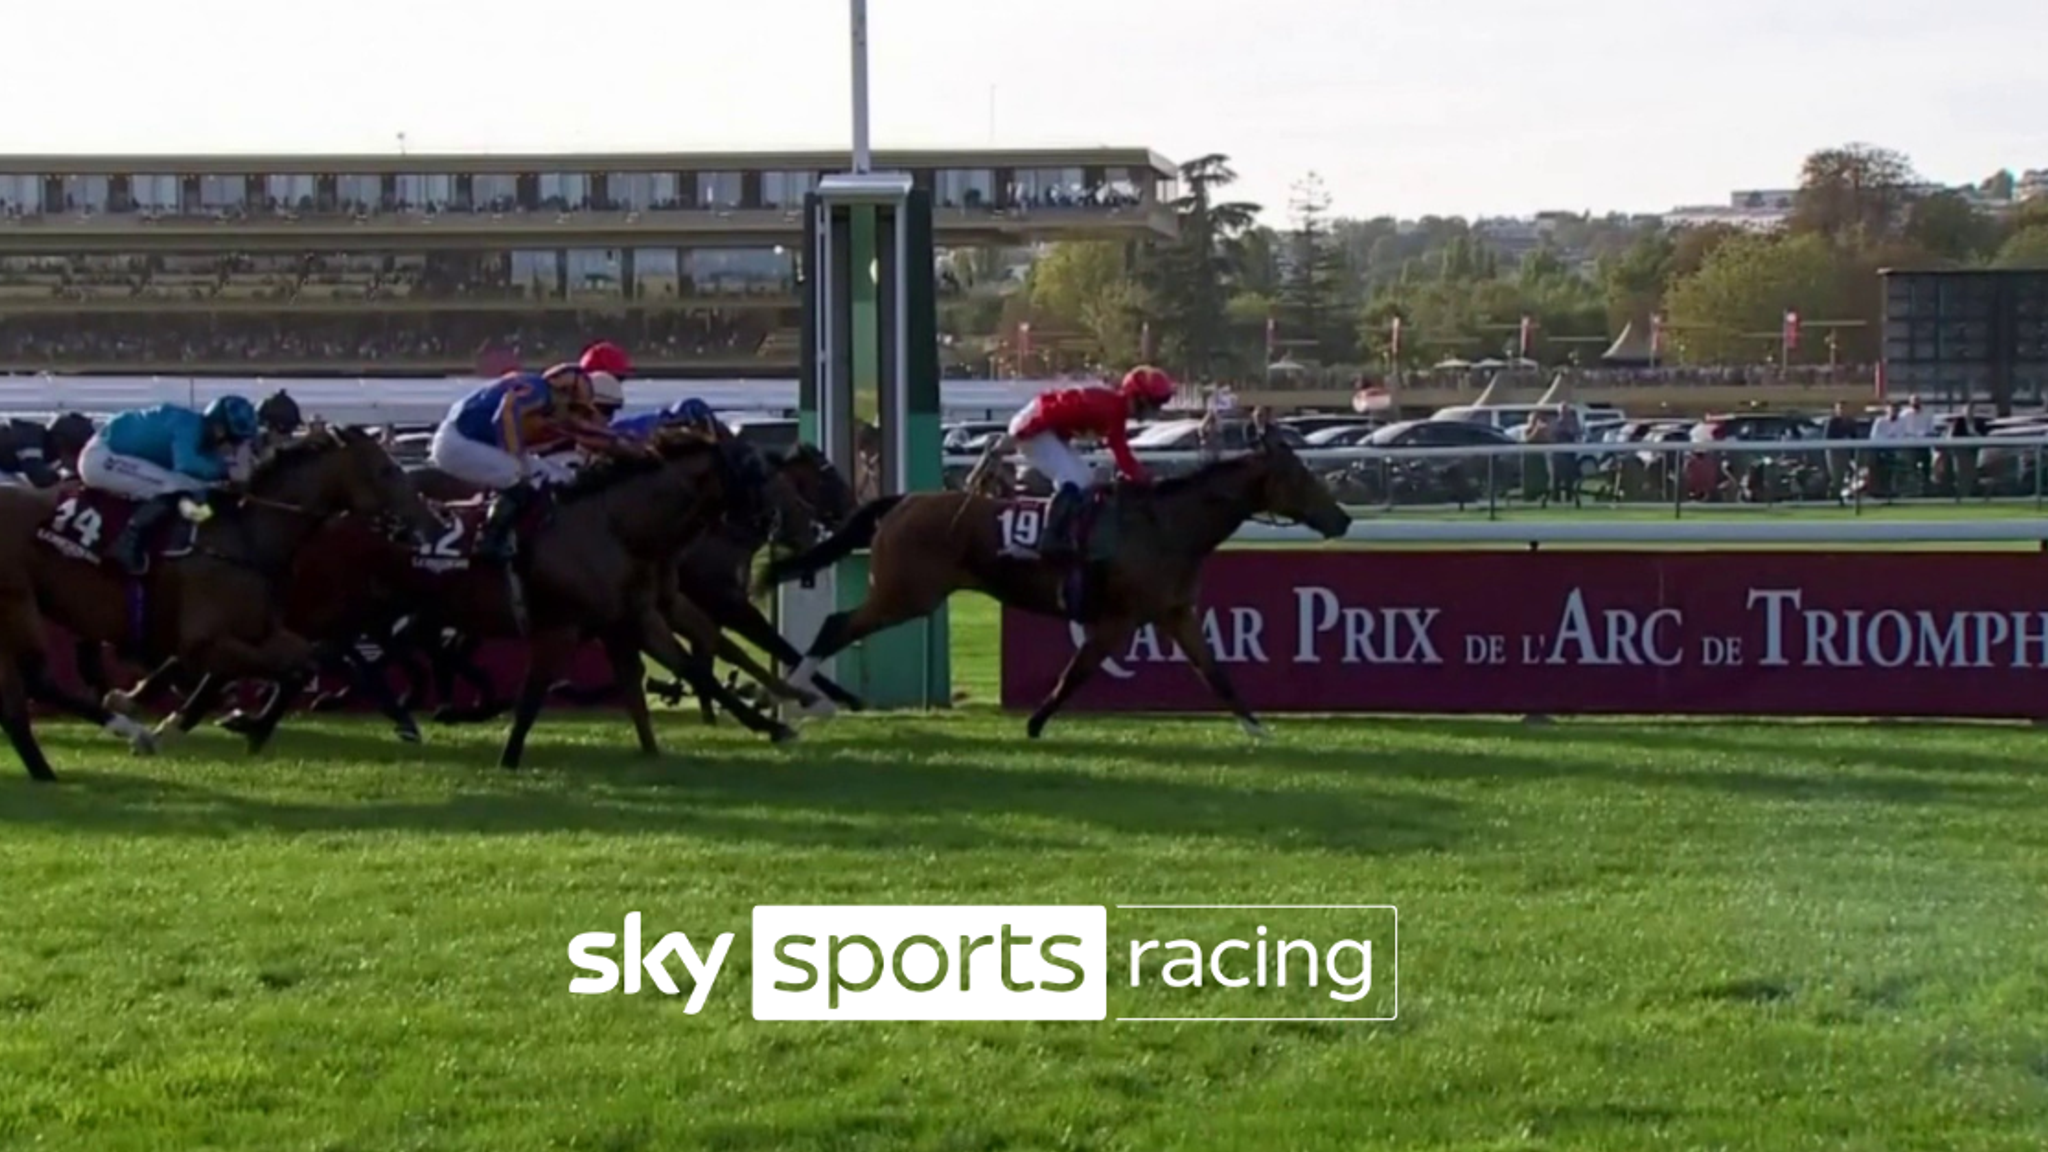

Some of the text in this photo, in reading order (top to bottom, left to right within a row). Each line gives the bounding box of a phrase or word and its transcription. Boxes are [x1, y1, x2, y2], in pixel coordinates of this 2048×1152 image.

[997, 508, 1039, 547] 19
[1069, 605, 1270, 679] AAR
[1294, 586, 1442, 662] PRIX
[1466, 635, 1504, 663] DE
[1703, 637, 1742, 664] DE
[1747, 588, 2048, 668] TRIOMPH
